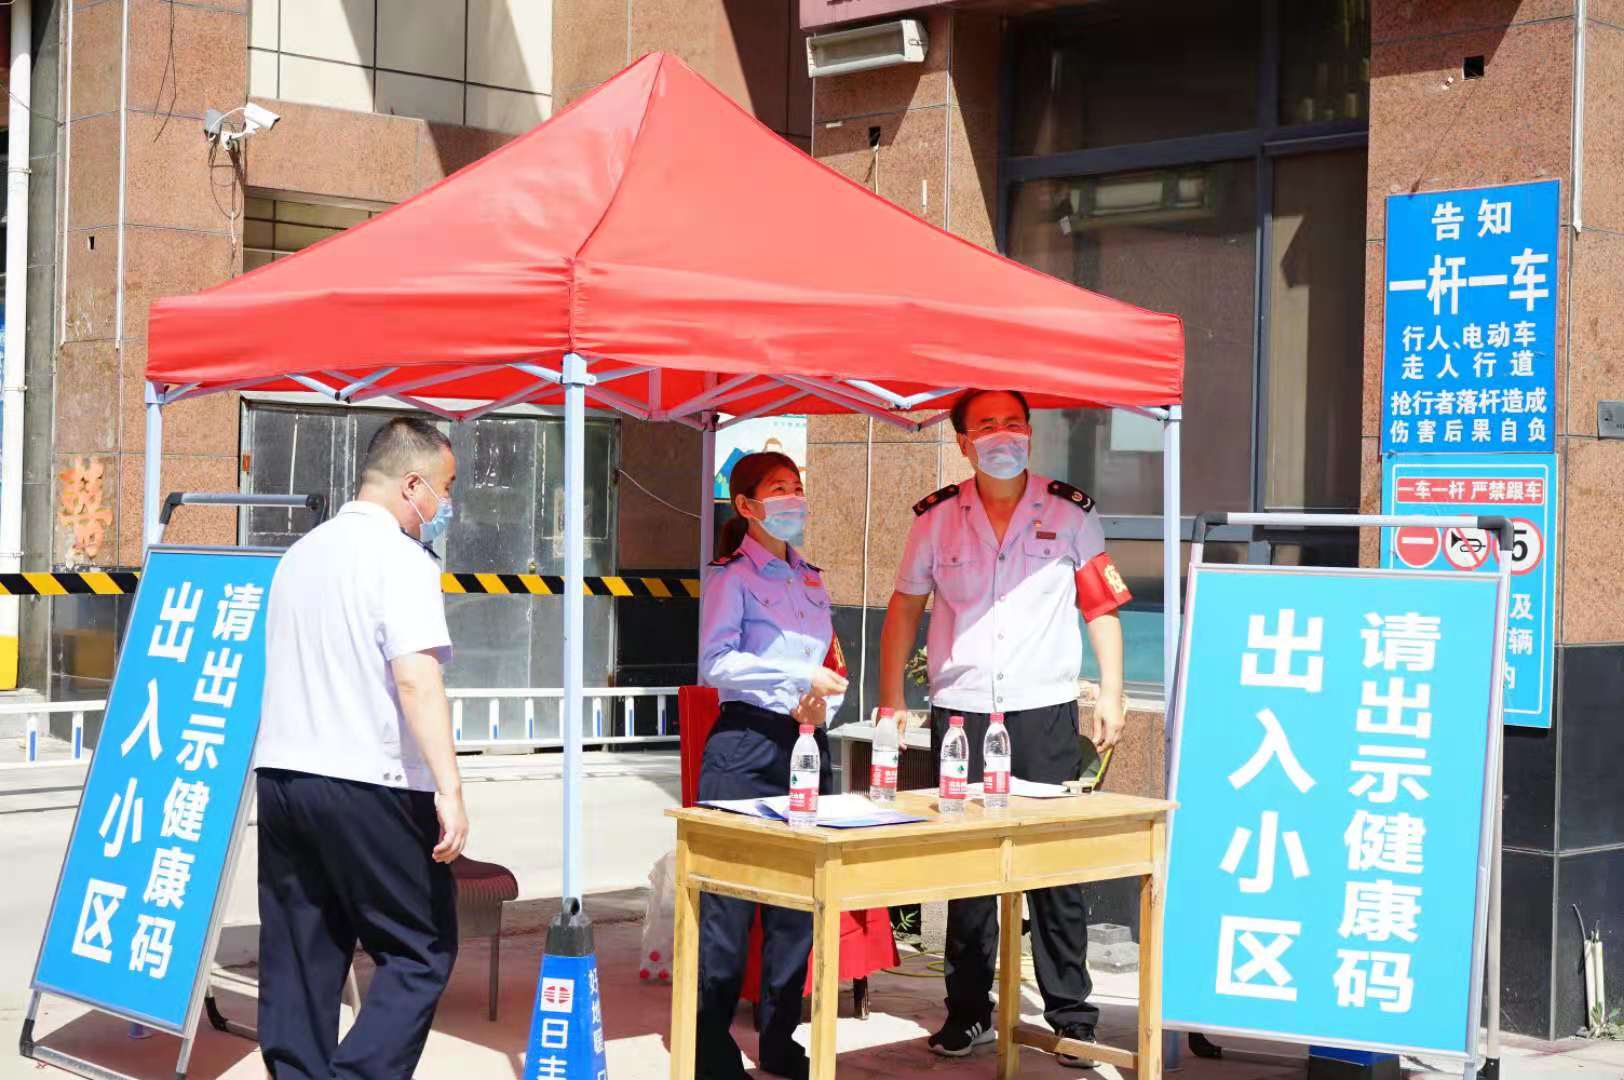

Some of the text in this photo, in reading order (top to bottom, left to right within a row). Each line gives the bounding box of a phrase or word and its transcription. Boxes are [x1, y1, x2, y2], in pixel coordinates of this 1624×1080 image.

[1431, 199, 1513, 241] 告知
[1388, 248, 1550, 316] 一杆一车
[1402, 320, 1537, 352] 行人、电动车
[1402, 348, 1535, 380] 走人行道
[1390, 386, 1548, 417] 抢行者落杆造成
[1389, 417, 1548, 443] 伤害后果自负
[1398, 480, 1542, 502] 一车一杆 严禁跟车
[70, 580, 204, 965] 出入小区
[129, 582, 263, 980] 请出示健康码
[1214, 608, 1325, 1003] 出入小区
[1331, 611, 1442, 1014] 请出示健康码
